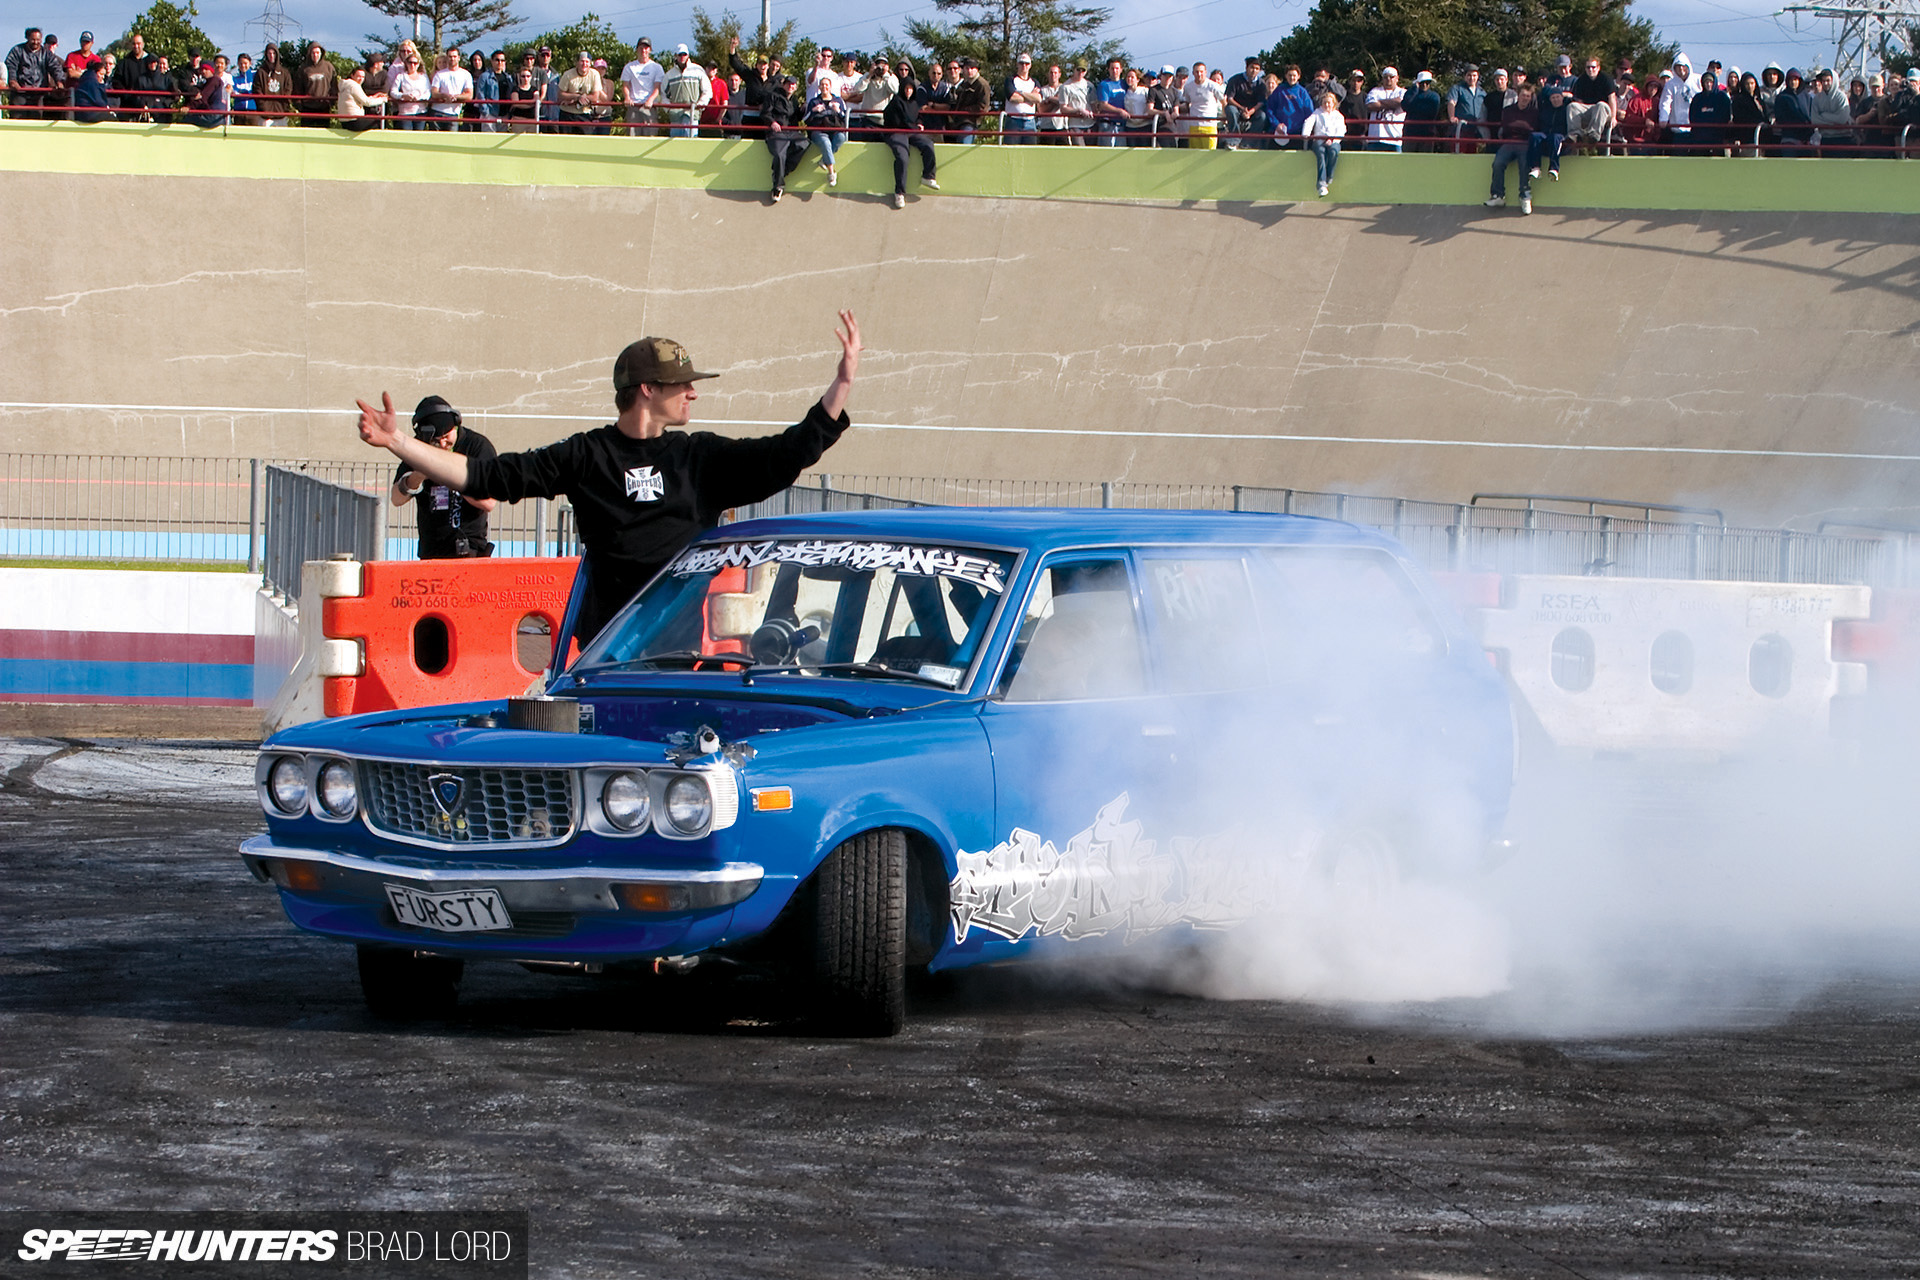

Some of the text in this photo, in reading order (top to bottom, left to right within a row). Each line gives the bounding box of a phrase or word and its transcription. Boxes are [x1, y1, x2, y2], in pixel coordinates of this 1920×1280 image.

[626, 475, 662, 491] CHOPPERS
[400, 578, 462, 596] RSEA
[515, 574, 556, 585] RHINO
[425, 595, 448, 609] 668
[470, 590, 498, 604] ROAD
[501, 590, 538, 602] SAFETY
[1540, 592, 1601, 611] RSEA
[390, 891, 498, 927] FURSTY
